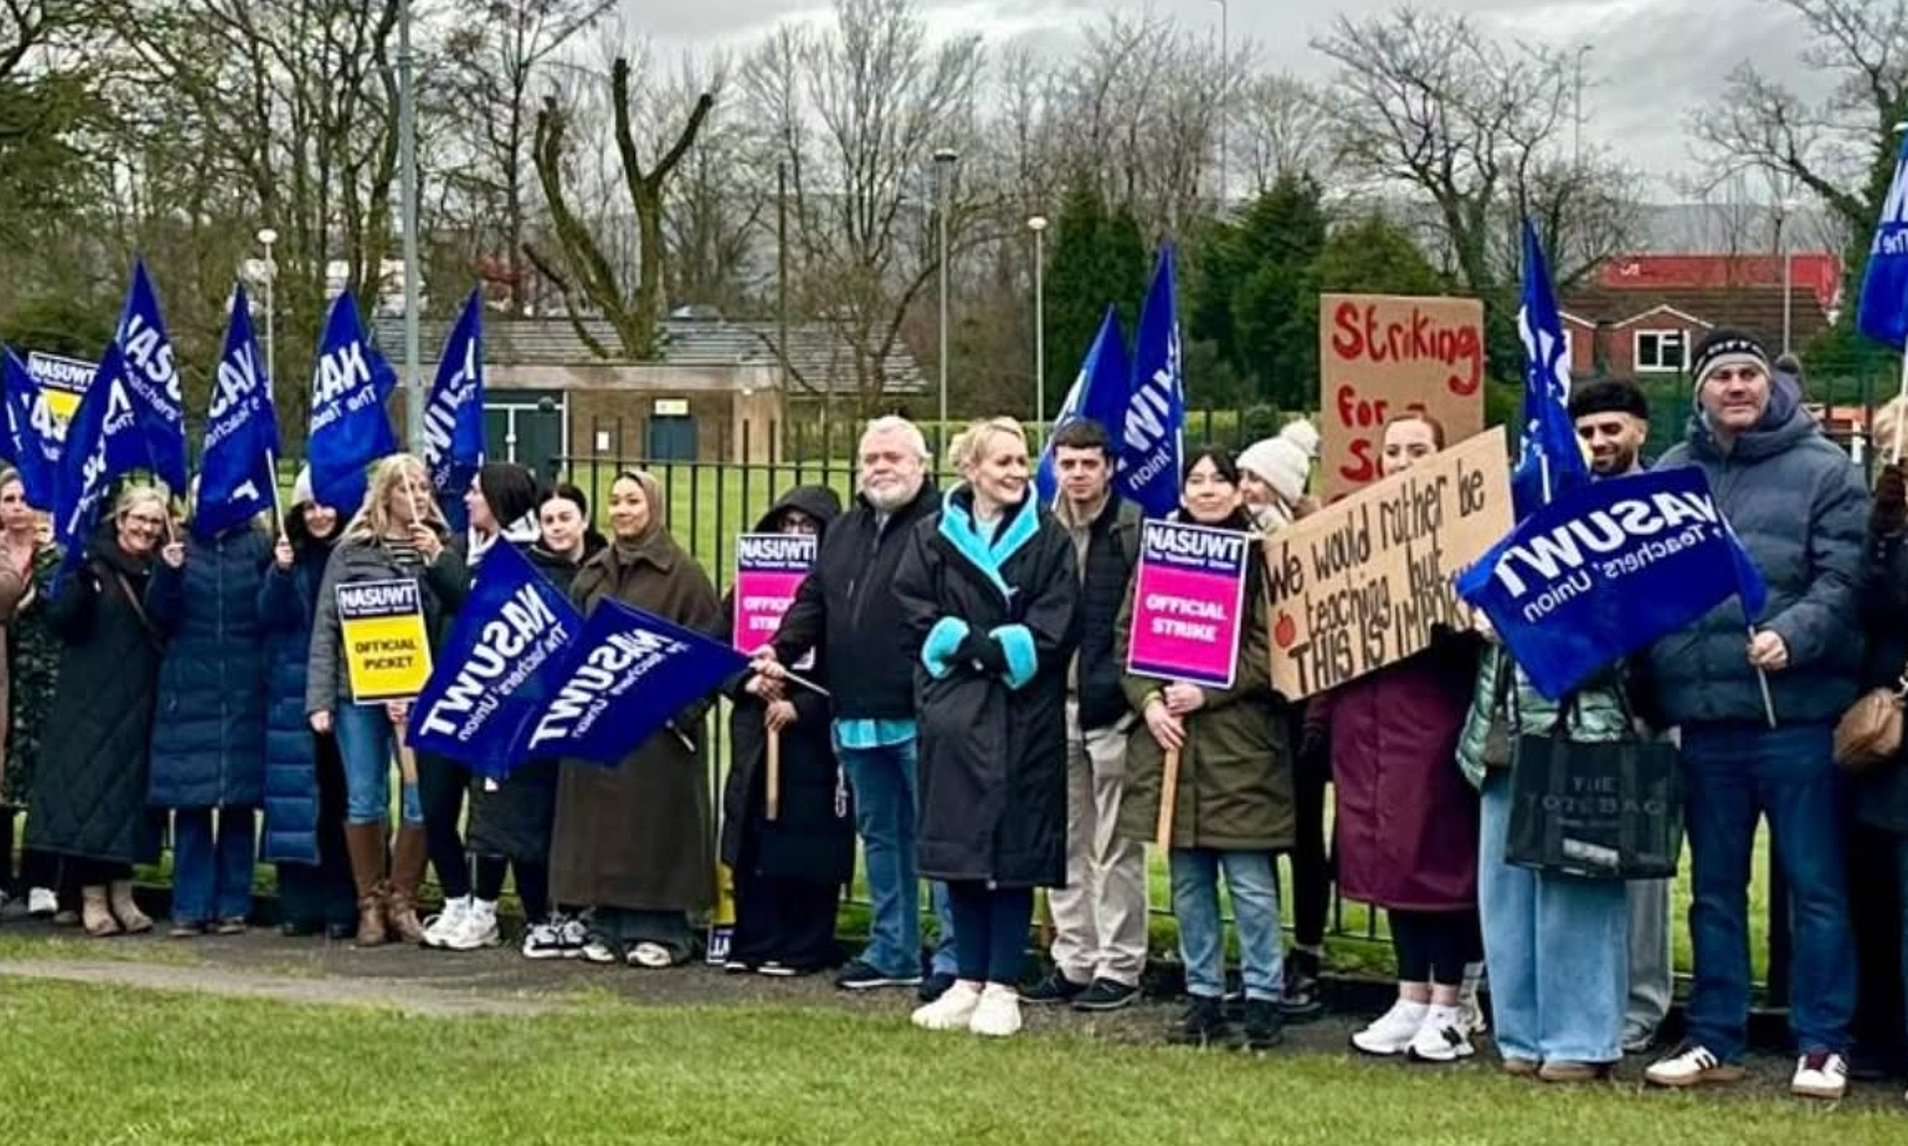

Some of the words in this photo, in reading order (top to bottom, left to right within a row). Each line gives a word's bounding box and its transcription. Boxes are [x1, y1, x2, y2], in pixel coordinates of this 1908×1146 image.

[1333, 302, 1482, 395] Striking
[1338, 385, 1388, 428] for
[1147, 526, 1242, 561] NASUWT
[1262, 541, 1304, 605] We
[1311, 502, 1371, 582] would
[1379, 475, 1447, 549] rather
[1457, 458, 1485, 518] be
[741, 539, 813, 561] NASUWT
[341, 586, 415, 609] NASUWT
[1146, 593, 1229, 621] OFFICIAL
[1305, 572, 1391, 638] teaching
[1152, 617, 1217, 643] STRIKE
[355, 639, 417, 654] OFFICIAL
[1288, 628, 1354, 695] THIS
[1358, 616, 1386, 669] IS
[364, 656, 413, 670] PICKET
[1572, 776, 1617, 792] THE
